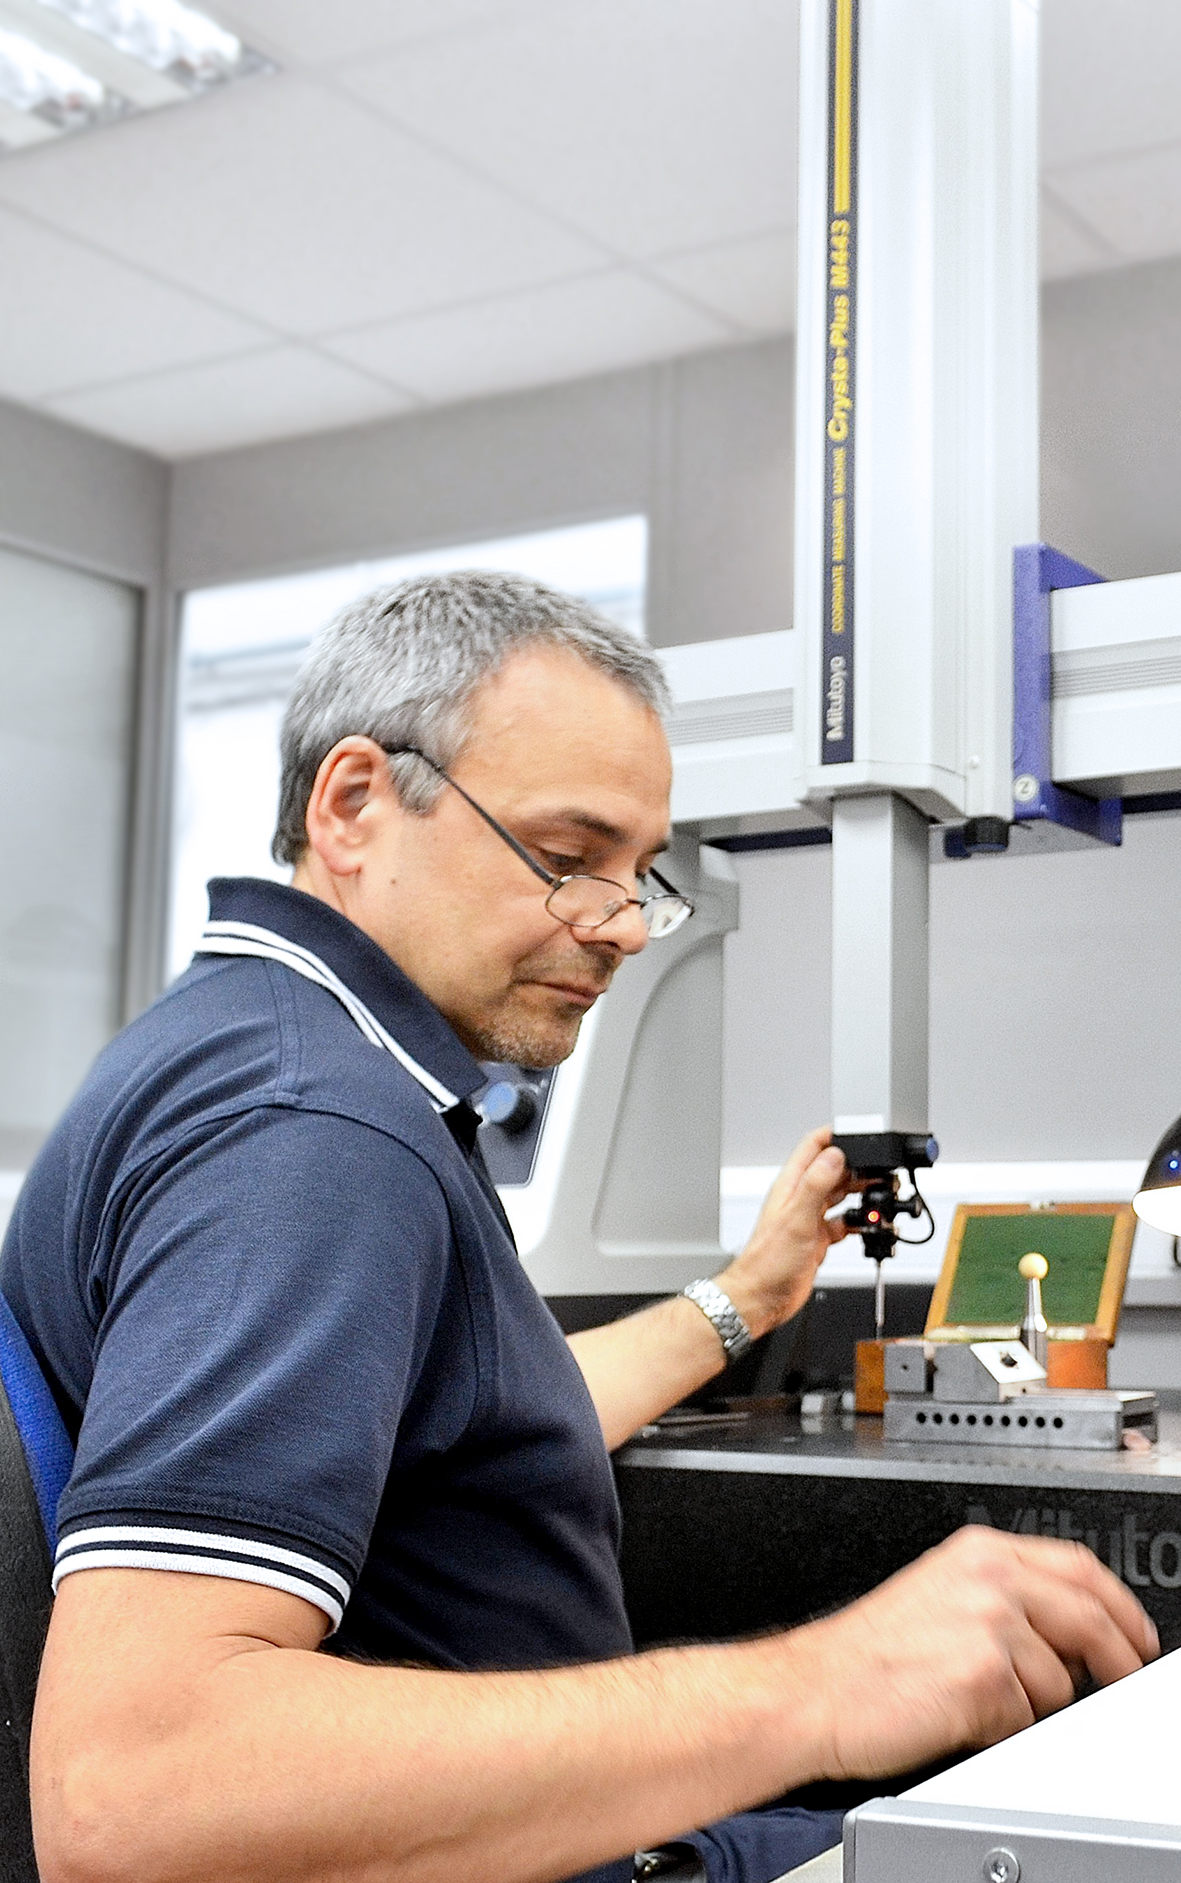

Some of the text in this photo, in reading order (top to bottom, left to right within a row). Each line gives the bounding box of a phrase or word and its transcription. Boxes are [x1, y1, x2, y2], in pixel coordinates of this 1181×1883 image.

[829, 219, 851, 289] M443
[832, 446, 846, 495] MACHINE
[832, 498, 846, 561] MEASURING
[832, 565, 846, 634] COORDINATE
[826, 656, 847, 742] Mitutoyo
